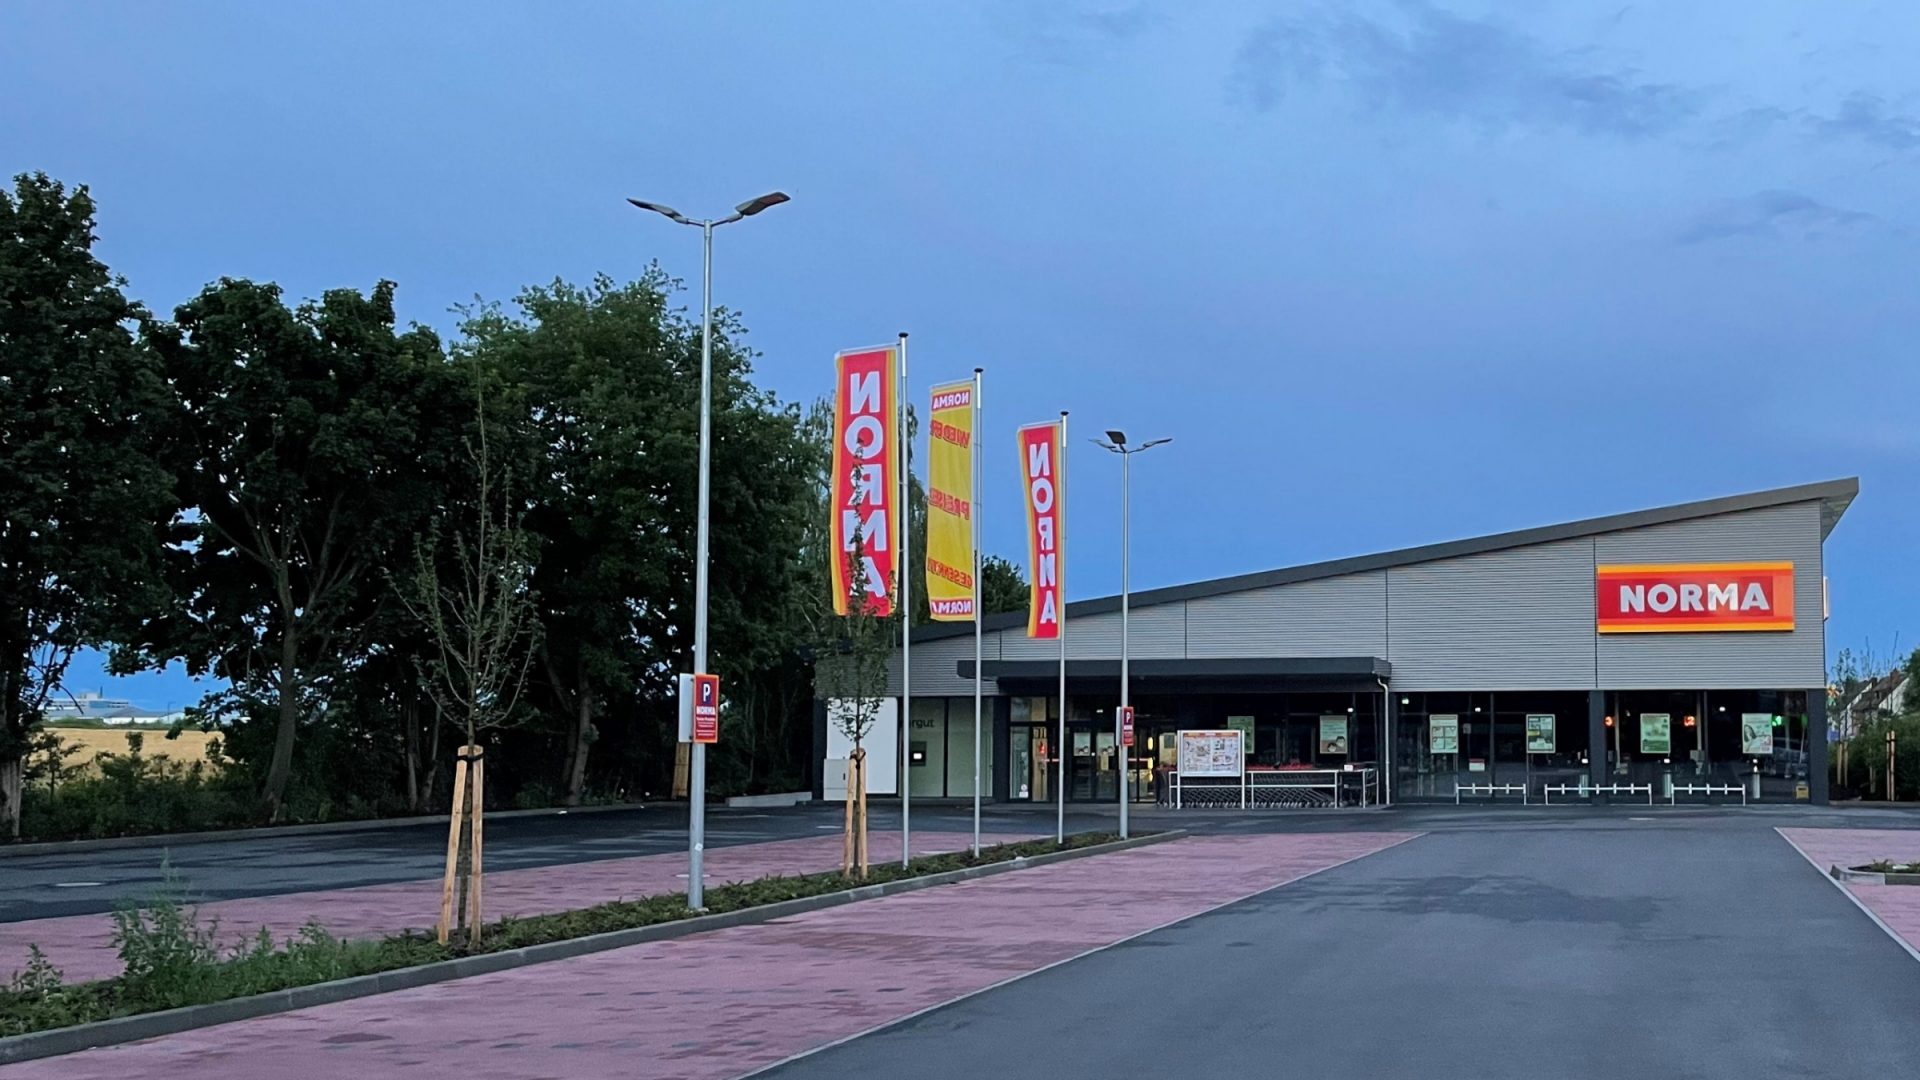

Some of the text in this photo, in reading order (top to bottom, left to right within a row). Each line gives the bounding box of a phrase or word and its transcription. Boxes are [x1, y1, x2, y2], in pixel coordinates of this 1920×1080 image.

[1619, 582, 1770, 613] NORMA
[703, 683, 711, 703] P
[1126, 711, 1131, 724] P
